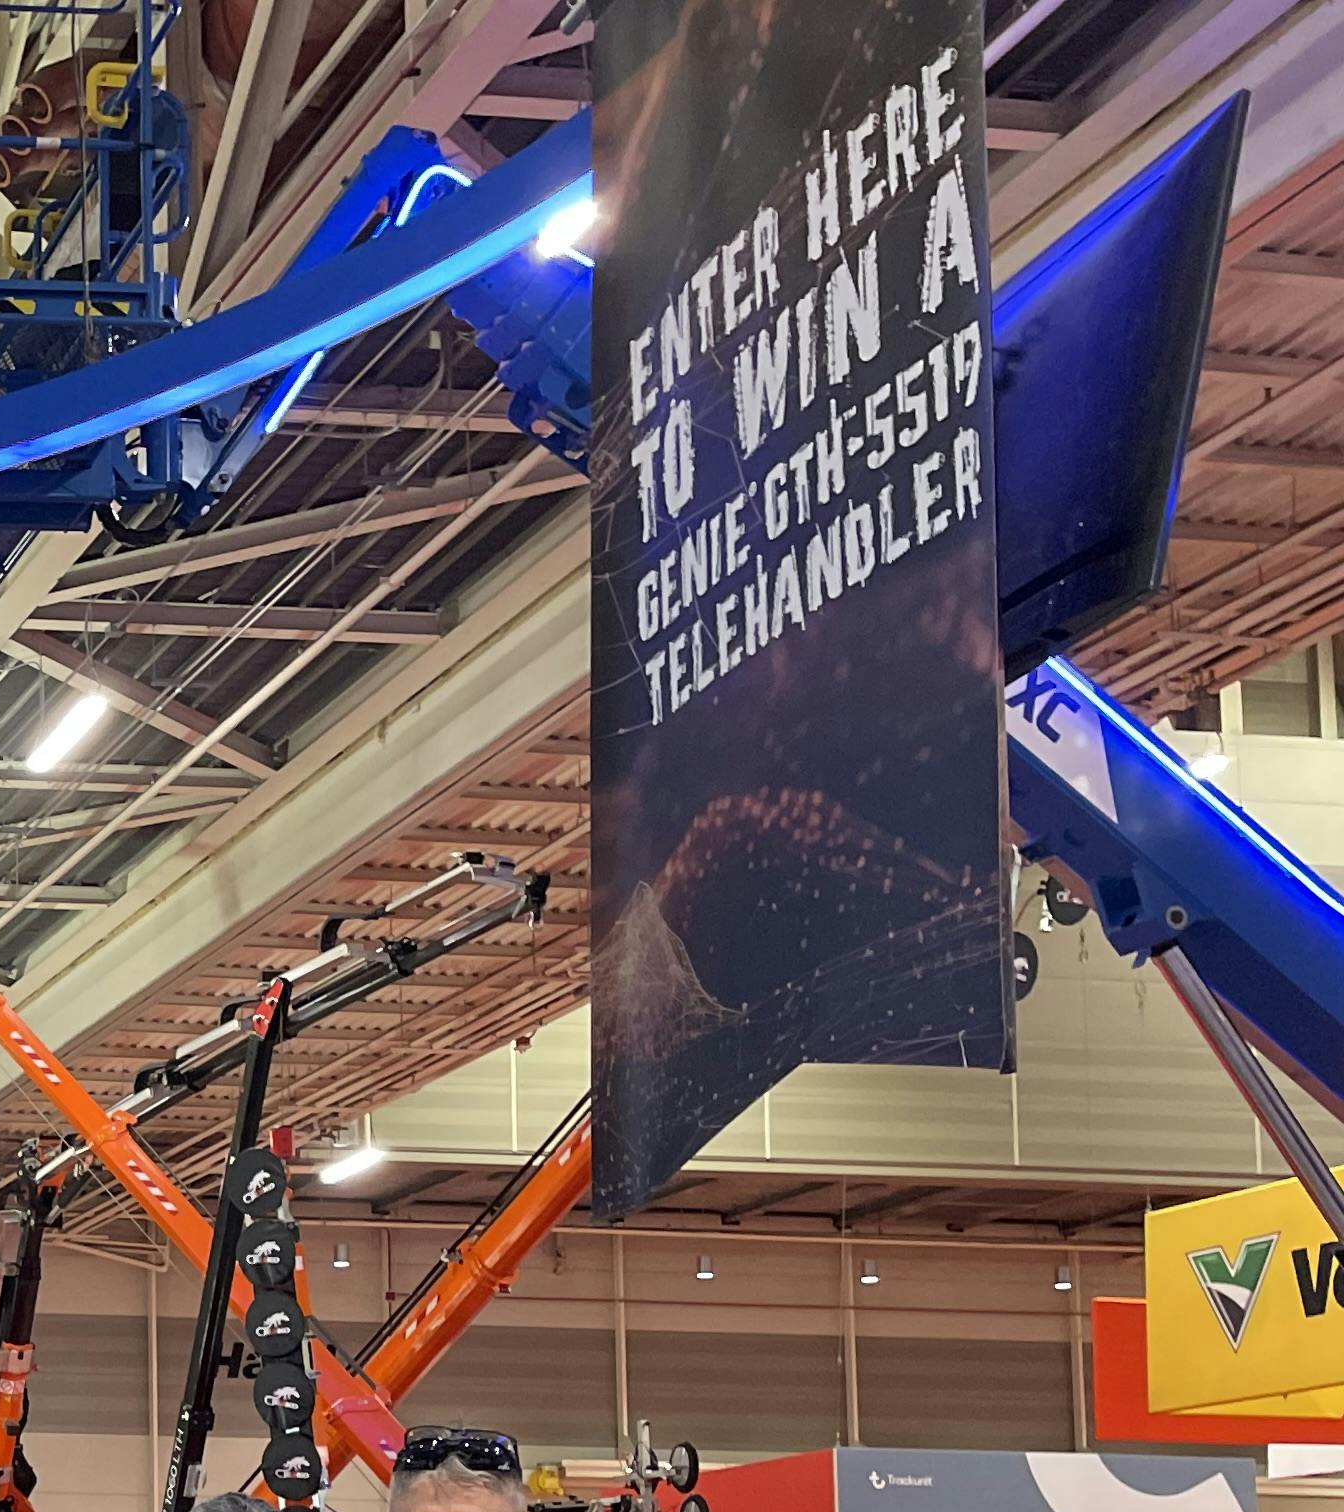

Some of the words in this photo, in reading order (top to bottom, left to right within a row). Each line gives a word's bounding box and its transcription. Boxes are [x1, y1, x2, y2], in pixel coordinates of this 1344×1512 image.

[629, 205, 780, 426] ENTER
[806, 47, 965, 260] HERE
[630, 398, 695, 544] TO
[734, 229, 881, 459] WIN
[922, 154, 981, 313] A
[637, 491, 750, 641] GENIE
[762, 320, 982, 547] GTH-5519
[645, 427, 982, 726] TELEHANDLER
